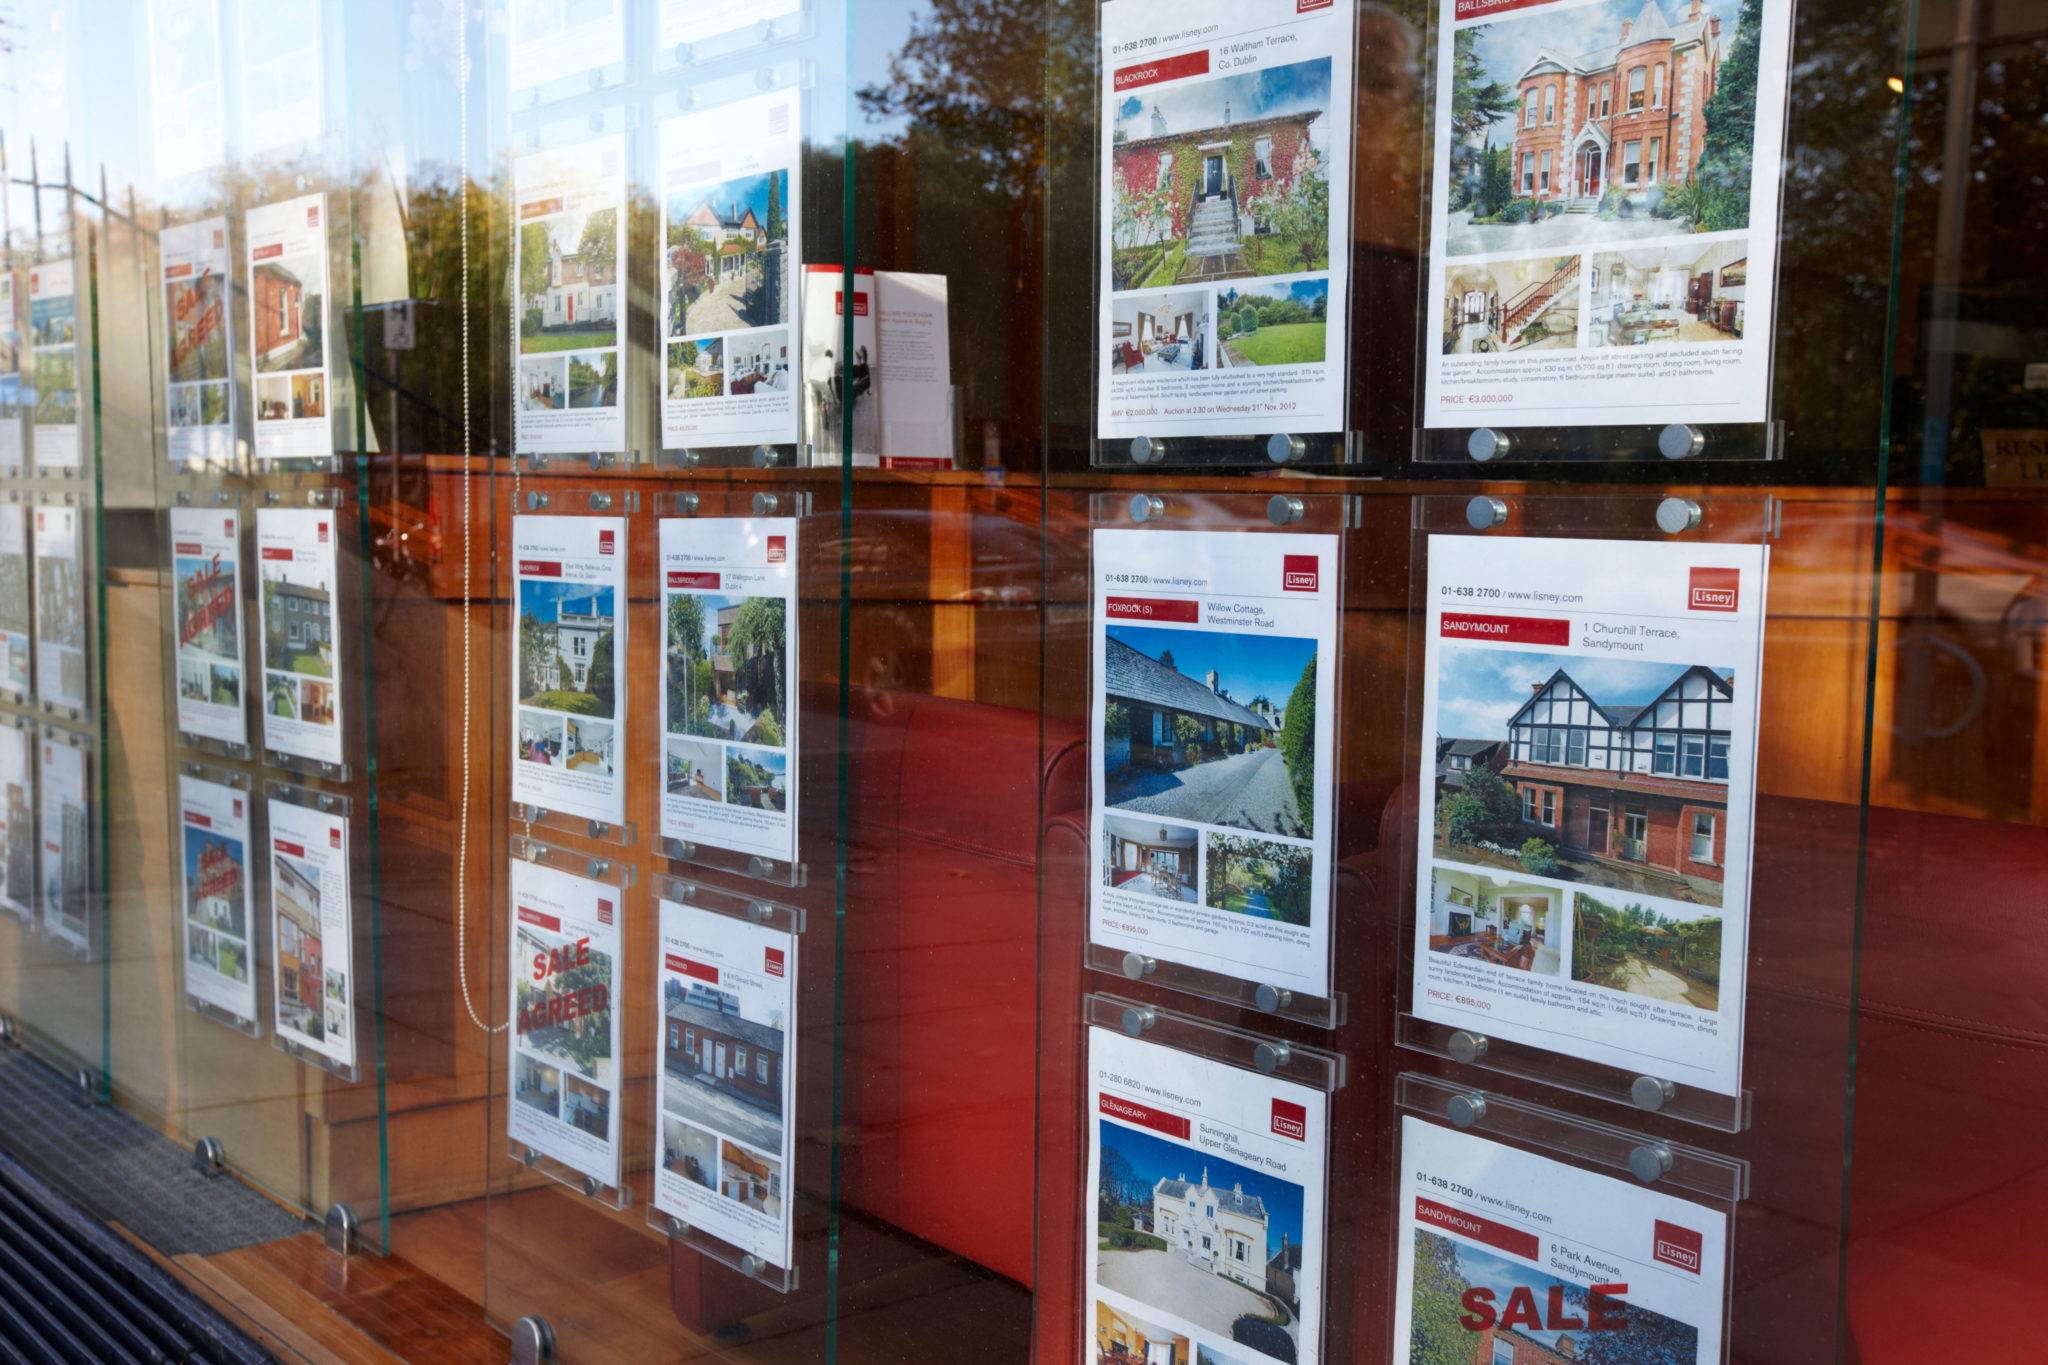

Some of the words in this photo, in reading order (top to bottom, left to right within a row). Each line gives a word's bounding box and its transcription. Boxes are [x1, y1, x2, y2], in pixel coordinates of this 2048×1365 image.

[1113, 41, 1137, 54] 01-638
[1139, 37, 1157, 48] 2700
[1162, 24, 1218, 42] www.lisney.com
[1219, 47, 1228, 56] 16
[1230, 40, 1264, 55] Waltham
[1266, 34, 1297, 48] Terrace,
[1218, 60, 1232, 70] Co.
[1234, 54, 1258, 68] Dublin
[1116, 68, 1158, 85] BLACKROCK
[1216, 405, 1250, 413] Wednesday
[1106, 574, 1129, 584] 01-638
[1131, 575, 1148, 584] 2700
[1153, 576, 1208, 588] www.lisney.com
[1288, 574, 1314, 586] Lisney
[1442, 586, 1474, 597] 01-638
[1477, 588, 1500, 598] 2700
[1508, 590, 1583, 604] www.lisney.com
[1695, 591, 1732, 605] Lisney
[1108, 603, 1142, 613] FOXROCK
[1208, 602, 1232, 613] Willow
[1234, 604, 1265, 616] Cottage,
[1208, 616, 1252, 626] Westminster
[1254, 618, 1274, 628] Road
[1443, 620, 1510, 634] SANDYMOUNT
[1593, 622, 1636, 636] Churchill
[1640, 626, 1680, 640] Terrace,
[1582, 637, 1644, 652] Sandymount
[533, 936, 590, 980] SALE
[1428, 989, 1453, 1001] PRICE:
[1456, 994, 1491, 1010] €895,000
[517, 983, 608, 1036] AGREED
[1699, 1016, 1718, 1026] Large
[1099, 1070, 1122, 1084] 01-280
[1124, 1078, 1141, 1090] 6820
[1144, 1086, 1201, 1107] www.lisney.com
[1101, 1099, 1147, 1120] GLENAGEARY
[1200, 1123, 1240, 1145] Sunninghill,
[1275, 1117, 1301, 1134] Lisney
[1200, 1135, 1222, 1151] Upper
[1223, 1142, 1264, 1166] Glenageary
[1266, 1157, 1287, 1172] Road
[1416, 1171, 1448, 1190] 01-638
[1450, 1182, 1473, 1198] 2700
[1480, 1193, 1552, 1224] www.lisney.com
[1418, 1205, 1482, 1234] SANDYMOUNT
[1551, 1244, 1557, 1253] 6
[1560, 1246, 1581, 1261] Park
[1584, 1254, 1622, 1278] Avenue,
[1660, 1244, 1695, 1265] Lisney
[1550, 1257, 1610, 1287] Sandymount
[1460, 1283, 1629, 1331] SALE
